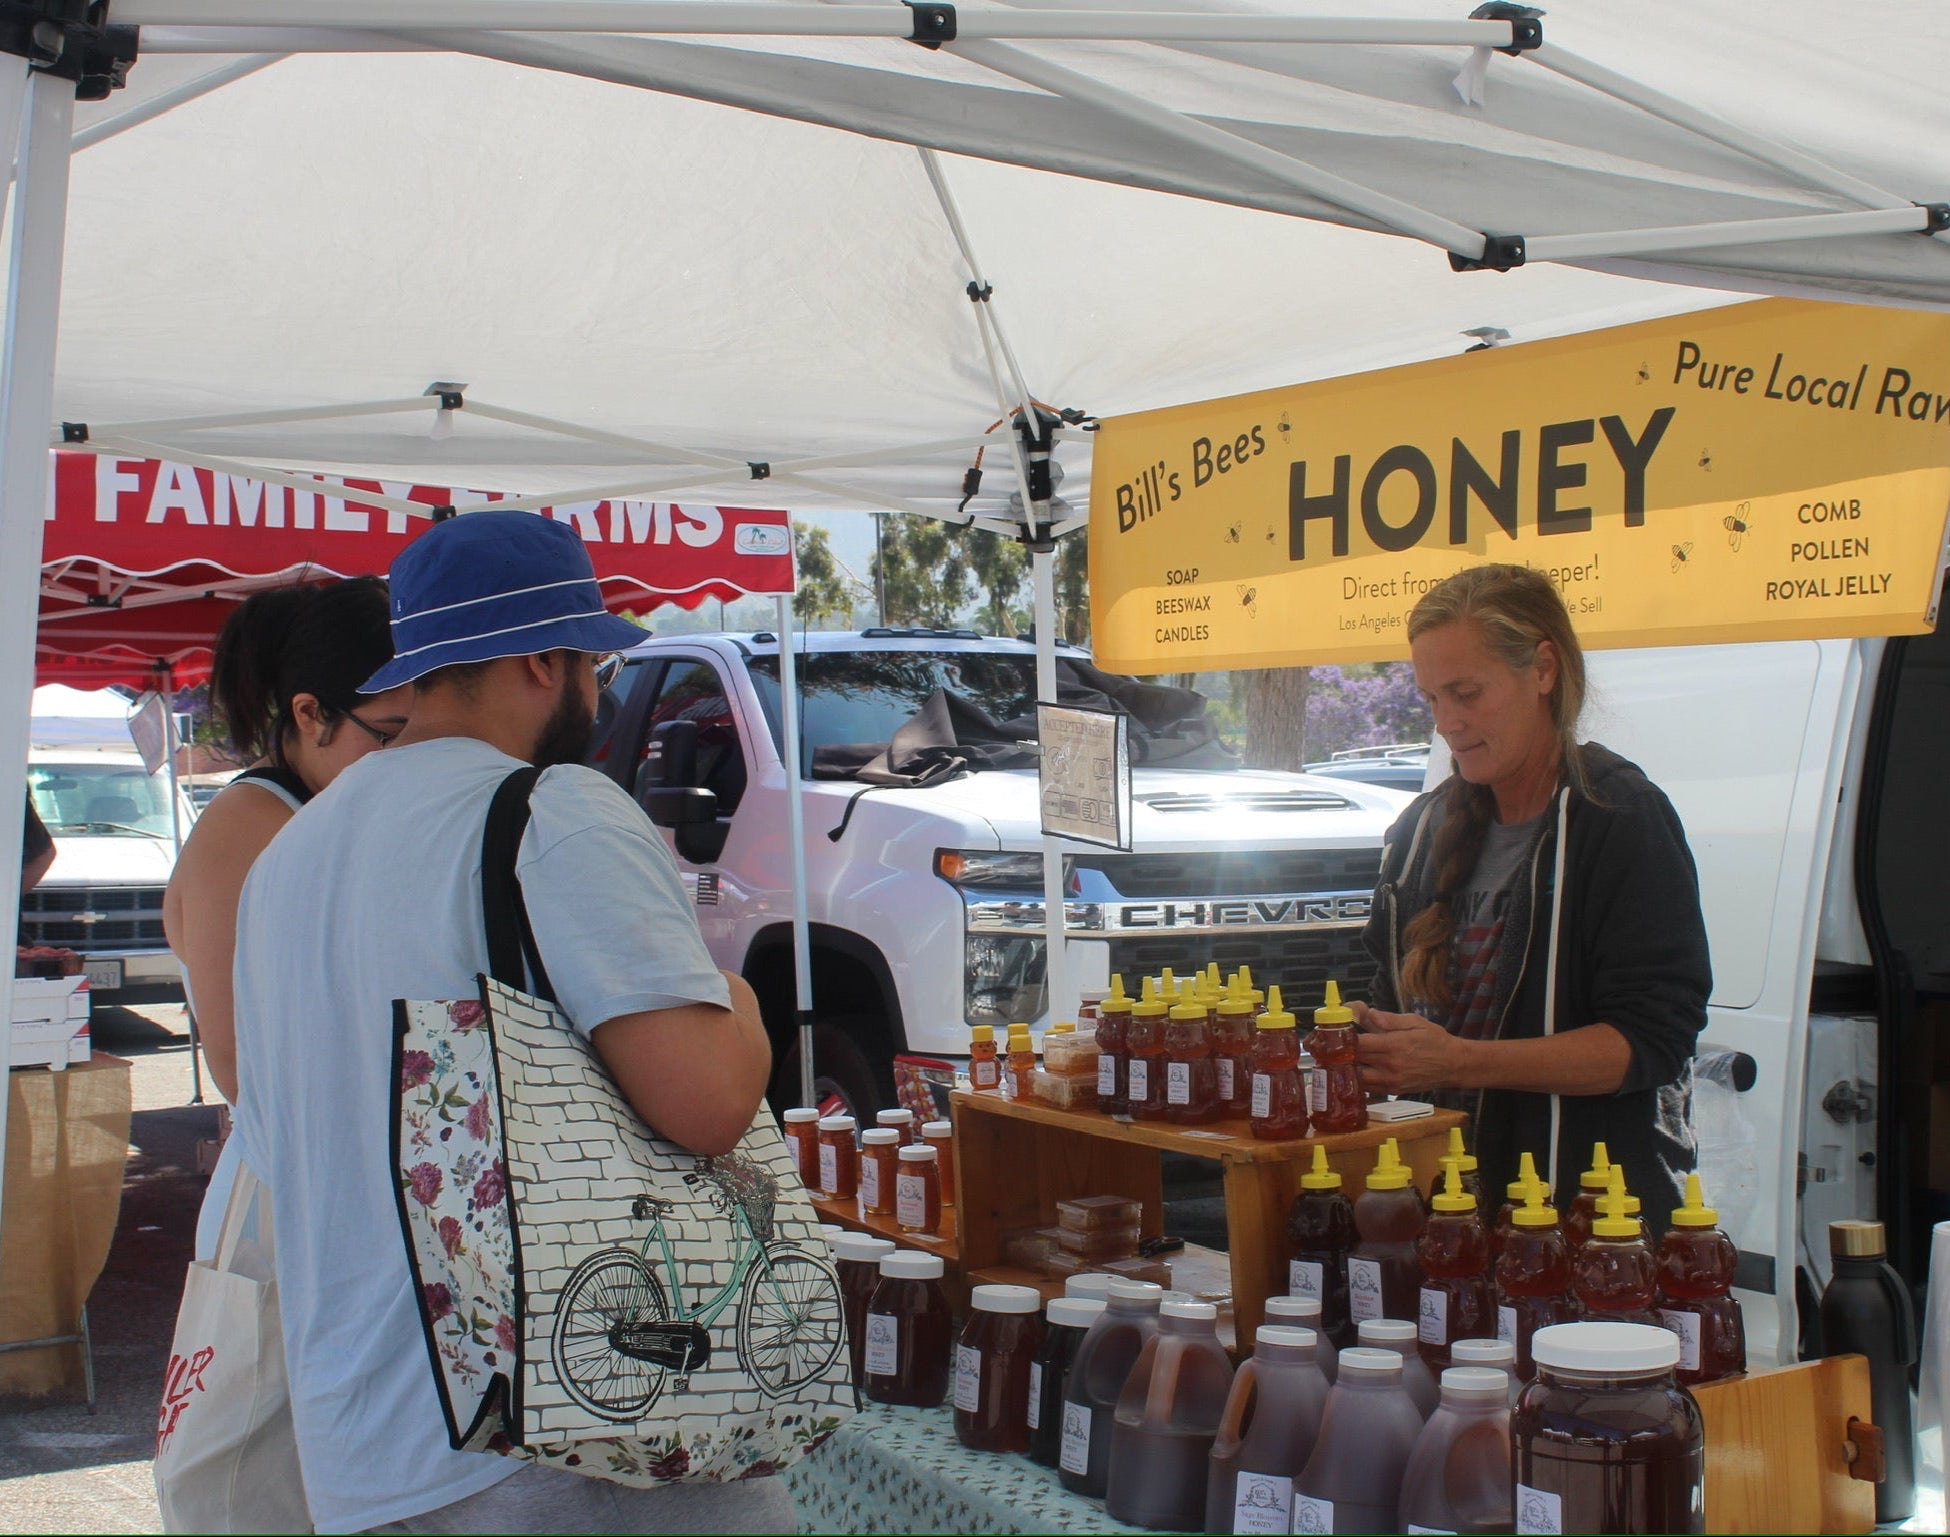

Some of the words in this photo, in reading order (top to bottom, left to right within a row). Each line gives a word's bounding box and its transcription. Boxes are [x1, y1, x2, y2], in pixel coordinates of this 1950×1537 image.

[1673, 341, 1754, 394] Pure
[1764, 353, 1868, 410] Local
[1116, 460, 1182, 534] Bill's
[1193, 424, 1266, 488] Bees
[1289, 406, 1676, 561] HONEY
[95, 453, 413, 534] FAMILY
[451, 487, 725, 549] RMS
[1798, 499, 1861, 524] COMB
[1791, 537, 1869, 562] POLLEN
[1166, 567, 1199, 586] SOAP
[1343, 573, 1397, 600] Direct
[1766, 578, 1830, 600] ROYAL
[1835, 573, 1892, 596] JELLY
[1156, 595, 1211, 615] BEESWAX
[1339, 614, 1356, 631] Los
[1360, 612, 1401, 634] Angeles
[1580, 595, 1602, 614] Sell
[1155, 624, 1209, 643] CANDLES
[1121, 898, 1372, 928] CHEVRO
